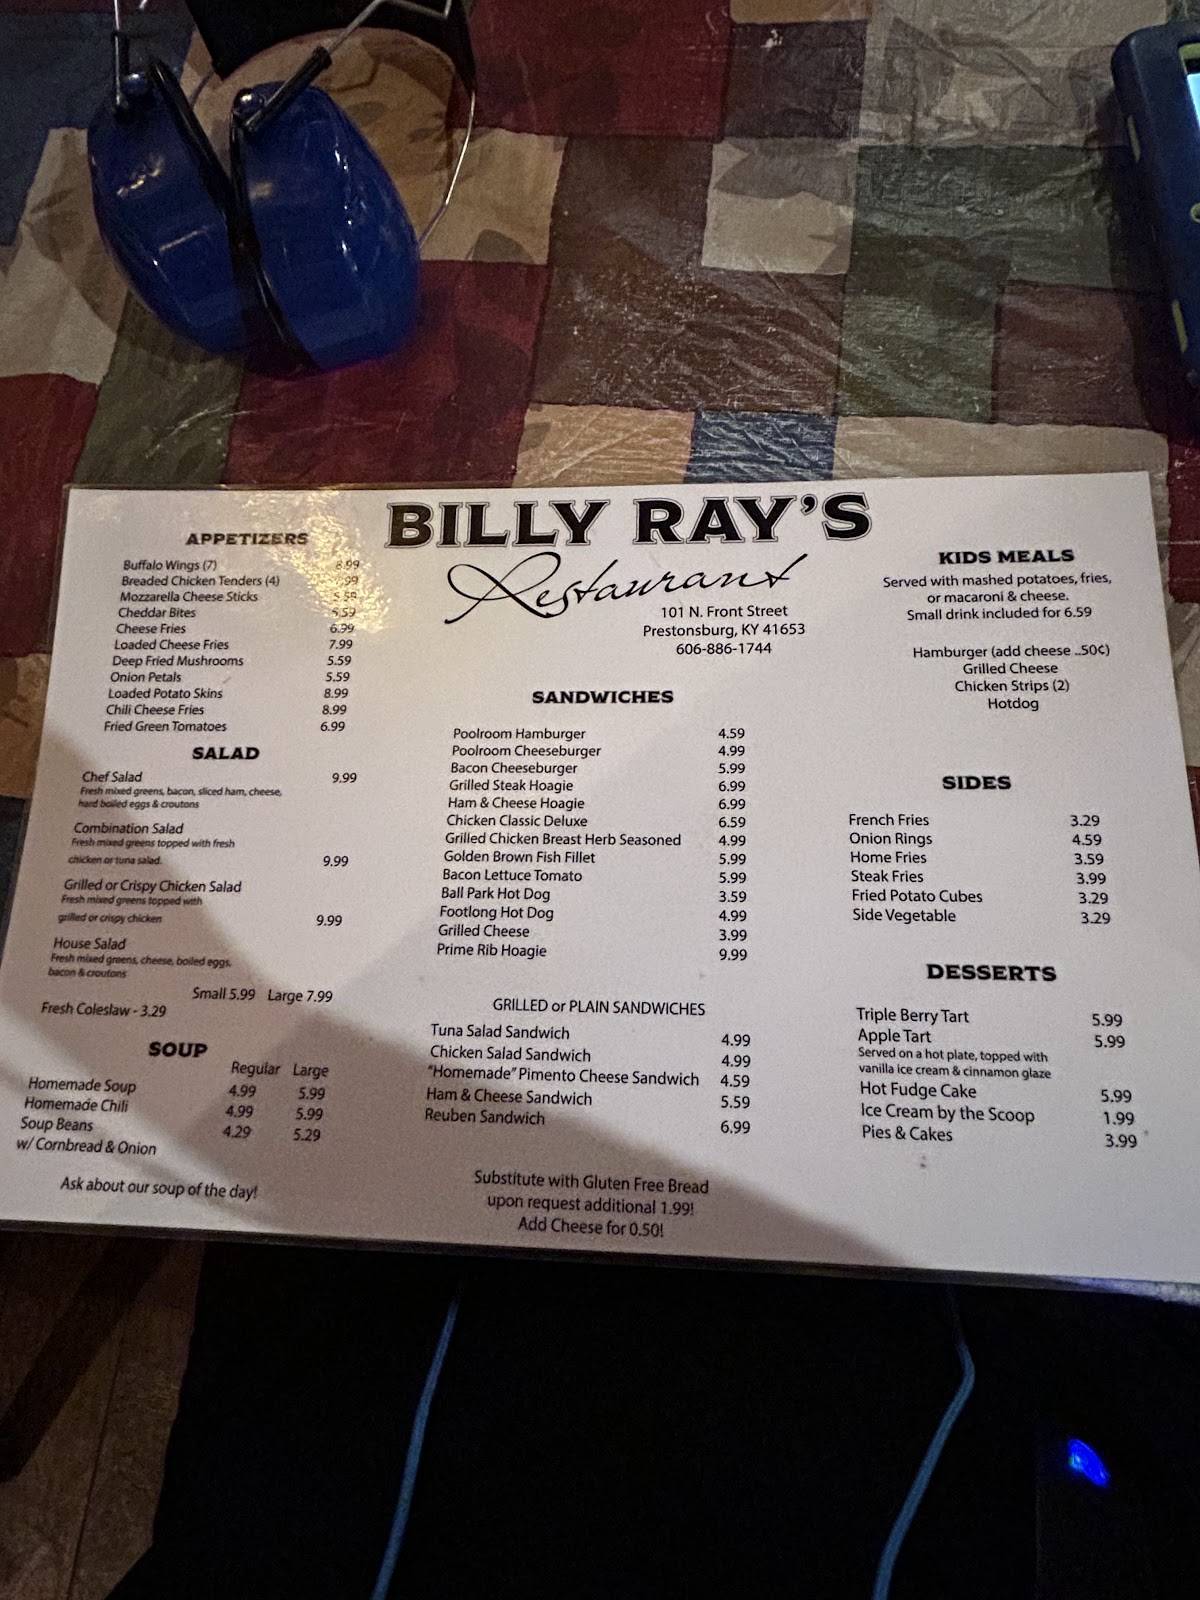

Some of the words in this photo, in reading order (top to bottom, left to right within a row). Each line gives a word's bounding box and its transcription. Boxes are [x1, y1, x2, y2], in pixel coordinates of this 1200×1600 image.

[385, 499, 609, 548] BILLY
[633, 492, 871, 545] RAY'S
[186, 531, 308, 545] APPETIZERS
[938, 550, 991, 564] KIDS
[996, 549, 1074, 563] MEALS
[121, 575, 168, 586] Breaded
[170, 575, 216, 586] Chicken
[218, 575, 262, 586] Tenders
[264, 575, 280, 587] (4)
[882, 575, 927, 587] Served
[930, 574, 958, 586] with
[962, 573, 1013, 585] mashed
[1016, 573, 1077, 587] potatoes,
[1080, 571, 1111, 584] fries,
[445, 551, 807, 624] Restaurant
[117, 606, 167, 618] Cheddar
[168, 606, 196, 618] Bites
[661, 606, 683, 618] 101
[689, 605, 702, 617] N.
[706, 605, 743, 617] Front
[746, 604, 787, 616] Street
[643, 623, 737, 638] Prestonsburg,
[741, 623, 759, 635] KY
[762, 622, 805, 635] 41653
[113, 638, 156, 650] Loaded
[158, 638, 200, 650] Cheese
[202, 639, 229, 650] Fries
[329, 638, 352, 649] 7.99
[676, 642, 771, 655] 606-886-1744
[111, 655, 143, 668] Deep
[145, 654, 174, 666] Fried
[176, 654, 243, 666] Mushrooms
[326, 655, 351, 665] 5.59
[954, 679, 1007, 691] Chicken
[1010, 679, 1048, 693] Strips
[1052, 678, 1069, 692] (2)
[532, 690, 673, 703] SANDWICHES
[987, 696, 1039, 711] Hotdog
[103, 720, 133, 731] Fried
[134, 720, 169, 731] Green
[171, 720, 227, 731] Tomatoes
[320, 720, 345, 731] 6.99
[718, 727, 745, 738] 4.59
[453, 727, 512, 739] Poolroom
[515, 727, 586, 742] Hamburger
[192, 746, 260, 759] SALAD
[81, 770, 110, 782] Chef
[110, 770, 143, 782] Salad
[331, 772, 357, 783] 9.99
[942, 775, 1011, 789] SIDES
[79, 786, 103, 794] Fresh
[104, 786, 132, 795] mixed
[197, 786, 223, 795] sliced
[449, 778, 489, 790] Grilled
[492, 778, 526, 791] Steak
[529, 779, 573, 793] Hoagie
[718, 780, 745, 791] 6.99
[73, 822, 149, 834] Combination
[151, 822, 184, 834] Salad
[445, 831, 486, 844] Grilled
[489, 831, 538, 844] Chicken
[542, 832, 581, 845] Breast
[584, 833, 616, 845] Herb
[619, 833, 681, 845] Seasoned
[718, 834, 746, 846] 4.99
[849, 831, 891, 844] Onion
[894, 832, 932, 847] Rings
[1071, 833, 1102, 846] 4.59
[322, 855, 348, 866] 9.99
[442, 868, 480, 880] Bacon
[484, 868, 531, 881] Lettuce
[533, 869, 582, 881] Tomato
[719, 871, 746, 883] 5.99
[63, 878, 103, 890] Grilled
[104, 881, 118, 890] or
[119, 879, 157, 894] Crispy
[158, 879, 206, 892] Chicken
[208, 879, 242, 893] Salad
[852, 888, 886, 901] Fried
[890, 889, 935, 902] Potato
[938, 889, 982, 902] Cubes
[1078, 891, 1108, 904] 3.29
[926, 963, 1056, 981] DESSERTS
[191, 986, 226, 999] Small
[228, 987, 255, 1000] 5.99
[267, 988, 303, 1005] Large
[306, 989, 333, 1003] 7.99
[40, 1001, 74, 1014] Fresh
[76, 1001, 131, 1016] Coleslaw
[139, 1004, 166, 1017] 3.29
[492, 997, 548, 1011] GRILLED
[551, 1002, 566, 1012] or
[569, 999, 609, 1013] PLAIN
[612, 1000, 705, 1015] SANDWICHES
[855, 1007, 896, 1024] Triple
[900, 1007, 938, 1025] Berry
[940, 1008, 969, 1023] Tart
[1092, 1013, 1122, 1027] 5.99
[148, 1041, 208, 1057] SOUP
[430, 1044, 482, 1058] Chicken
[486, 1045, 522, 1060] Salad
[525, 1047, 590, 1062] Sandwich
[858, 1046, 896, 1058] Served
[898, 1049, 913, 1058] on
[915, 1050, 922, 1058] a
[924, 1047, 944, 1060] hot
[979, 1050, 1020, 1063] topped
[1022, 1051, 1048, 1062] with
[721, 1054, 750, 1067] 4.99
[230, 1060, 280, 1077] Regular
[292, 1063, 329, 1080] Large
[28, 1076, 101, 1091] Homemade
[103, 1078, 136, 1095] Soup
[228, 1083, 256, 1097] 4.99
[297, 1086, 325, 1100] 5.99
[861, 1102, 881, 1116] Ice
[885, 1103, 933, 1118] Cream
[936, 1104, 955, 1123] by
[959, 1105, 984, 1120] the
[987, 1106, 1035, 1125] Scoop
[1103, 1111, 1134, 1125] 1.99
[16, 1136, 34, 1150] w/
[35, 1136, 103, 1152] Cornbread
[104, 1139, 115, 1153] &
[117, 1140, 156, 1155] Onion
[59, 1175, 84, 1190] Ask
[85, 1176, 125, 1192] about
[127, 1182, 150, 1193] our
[151, 1183, 185, 1198] soup
[187, 1181, 203, 1196] of
[204, 1181, 226, 1197] the
[228, 1183, 257, 1201] day!
[474, 1169, 544, 1186] Substitute
[547, 1173, 579, 1188] with
[582, 1174, 629, 1190] Gluten
[633, 1176, 664, 1192] Free
[668, 1177, 708, 1194] Bread
[487, 1195, 523, 1210] upon
[527, 1197, 580, 1212] request
[584, 1196, 655, 1214] additional
[660, 1201, 693, 1216] 1.99!
[517, 1215, 547, 1232] Add
[550, 1217, 602, 1234] Cheese
[606, 1219, 626, 1235] for
[629, 1221, 663, 1238] 0.50!
